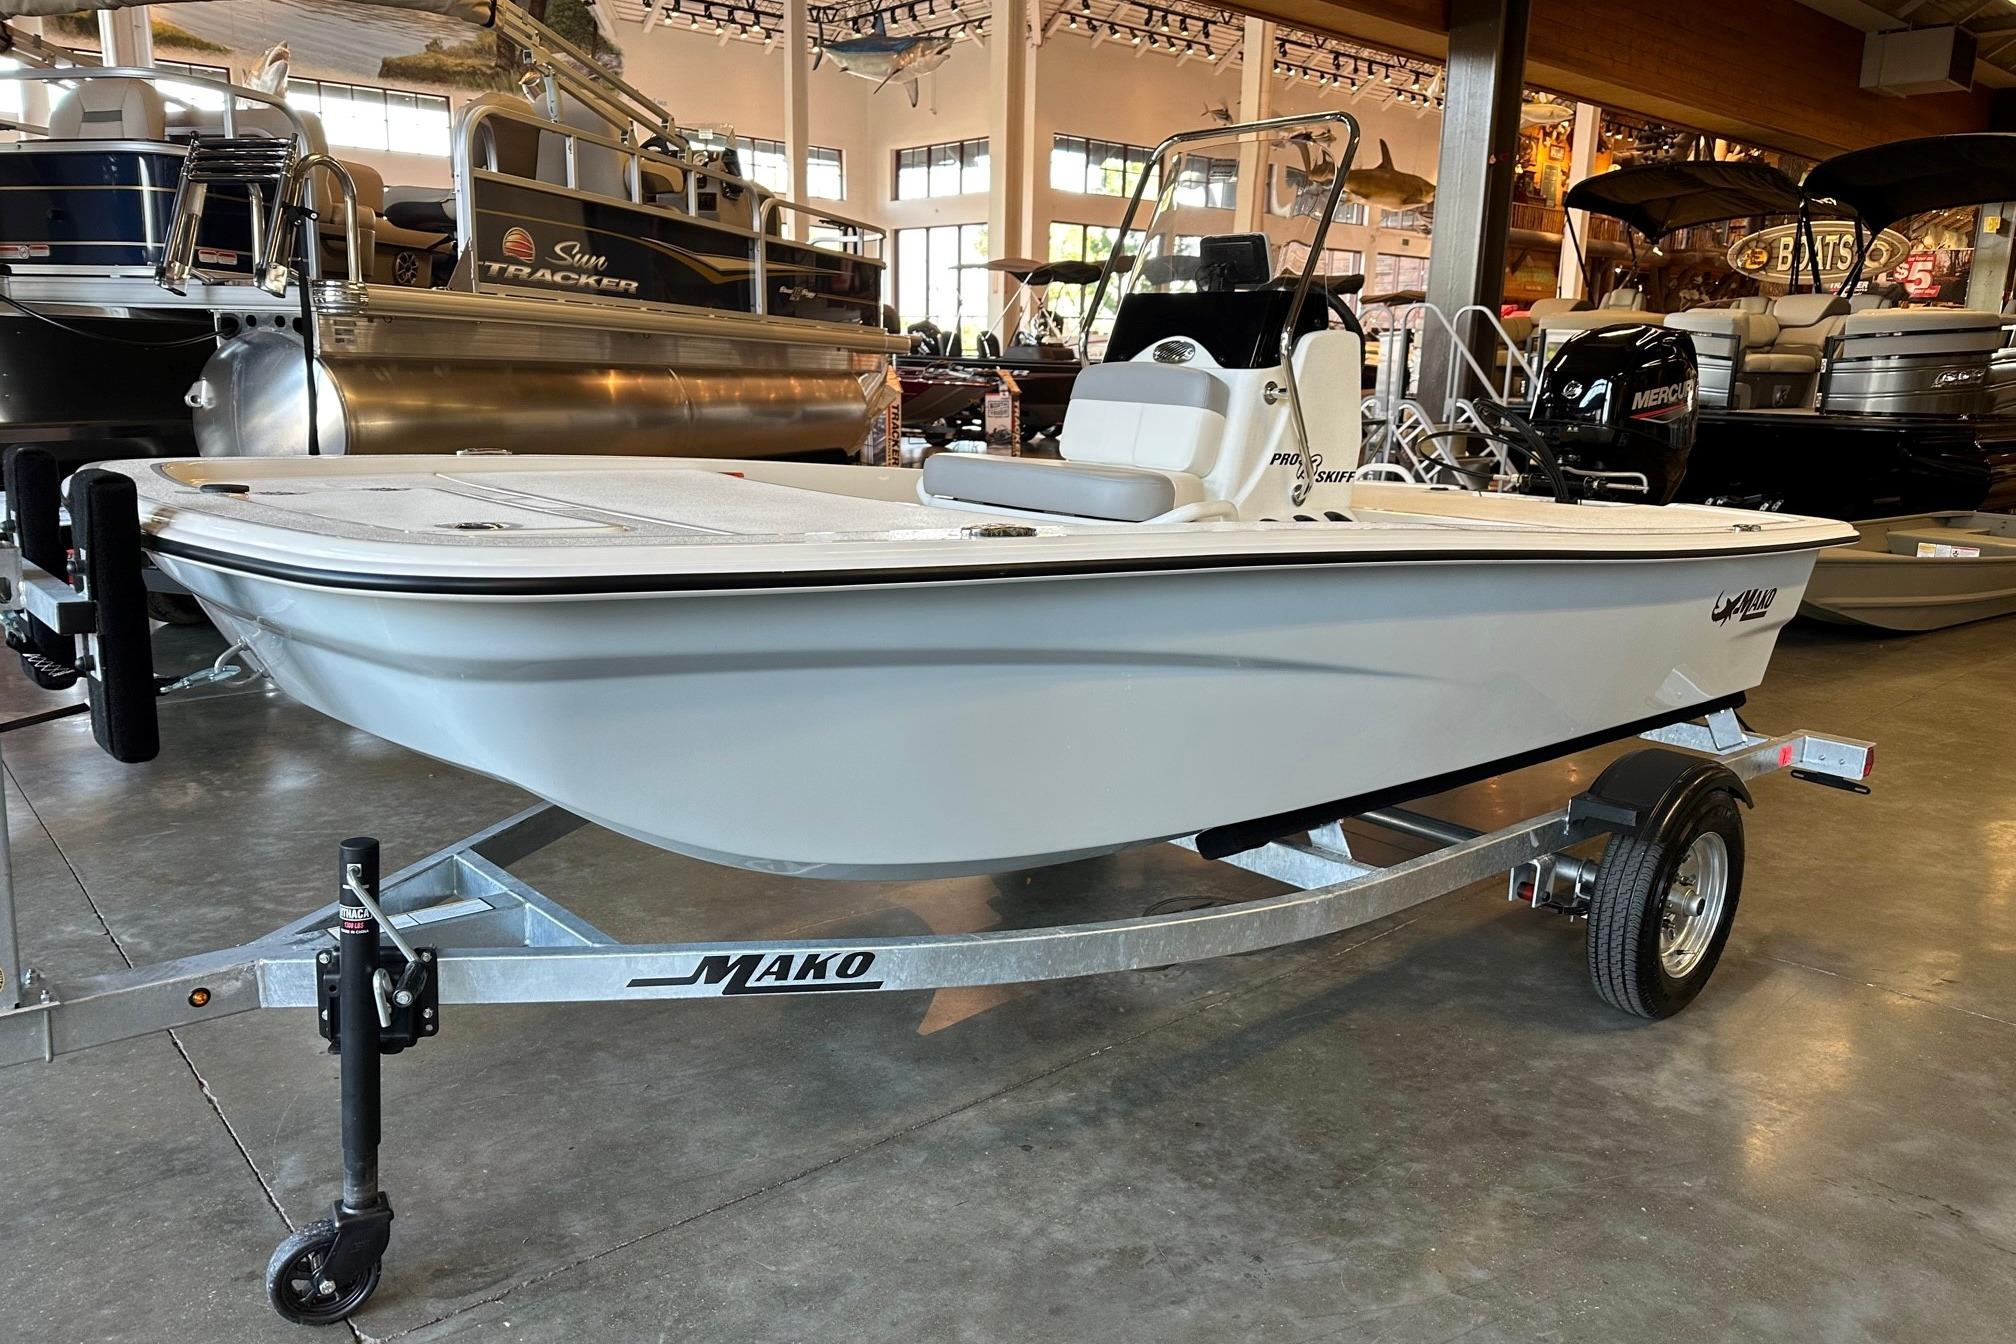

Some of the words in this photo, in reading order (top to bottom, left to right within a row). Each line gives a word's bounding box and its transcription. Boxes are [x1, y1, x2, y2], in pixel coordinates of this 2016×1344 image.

[545, 241, 608, 271] Sun
[480, 261, 639, 295] TRACKER
[1894, 261, 1934, 293] $5
[1631, 379, 1695, 410] MERCUR
[892, 404, 900, 467] TRACKER
[1269, 453, 1300, 466] PRO
[1315, 471, 1357, 483] SKIFF
[1732, 588, 1778, 621] MAKO
[626, 951, 884, 995] MAKO
